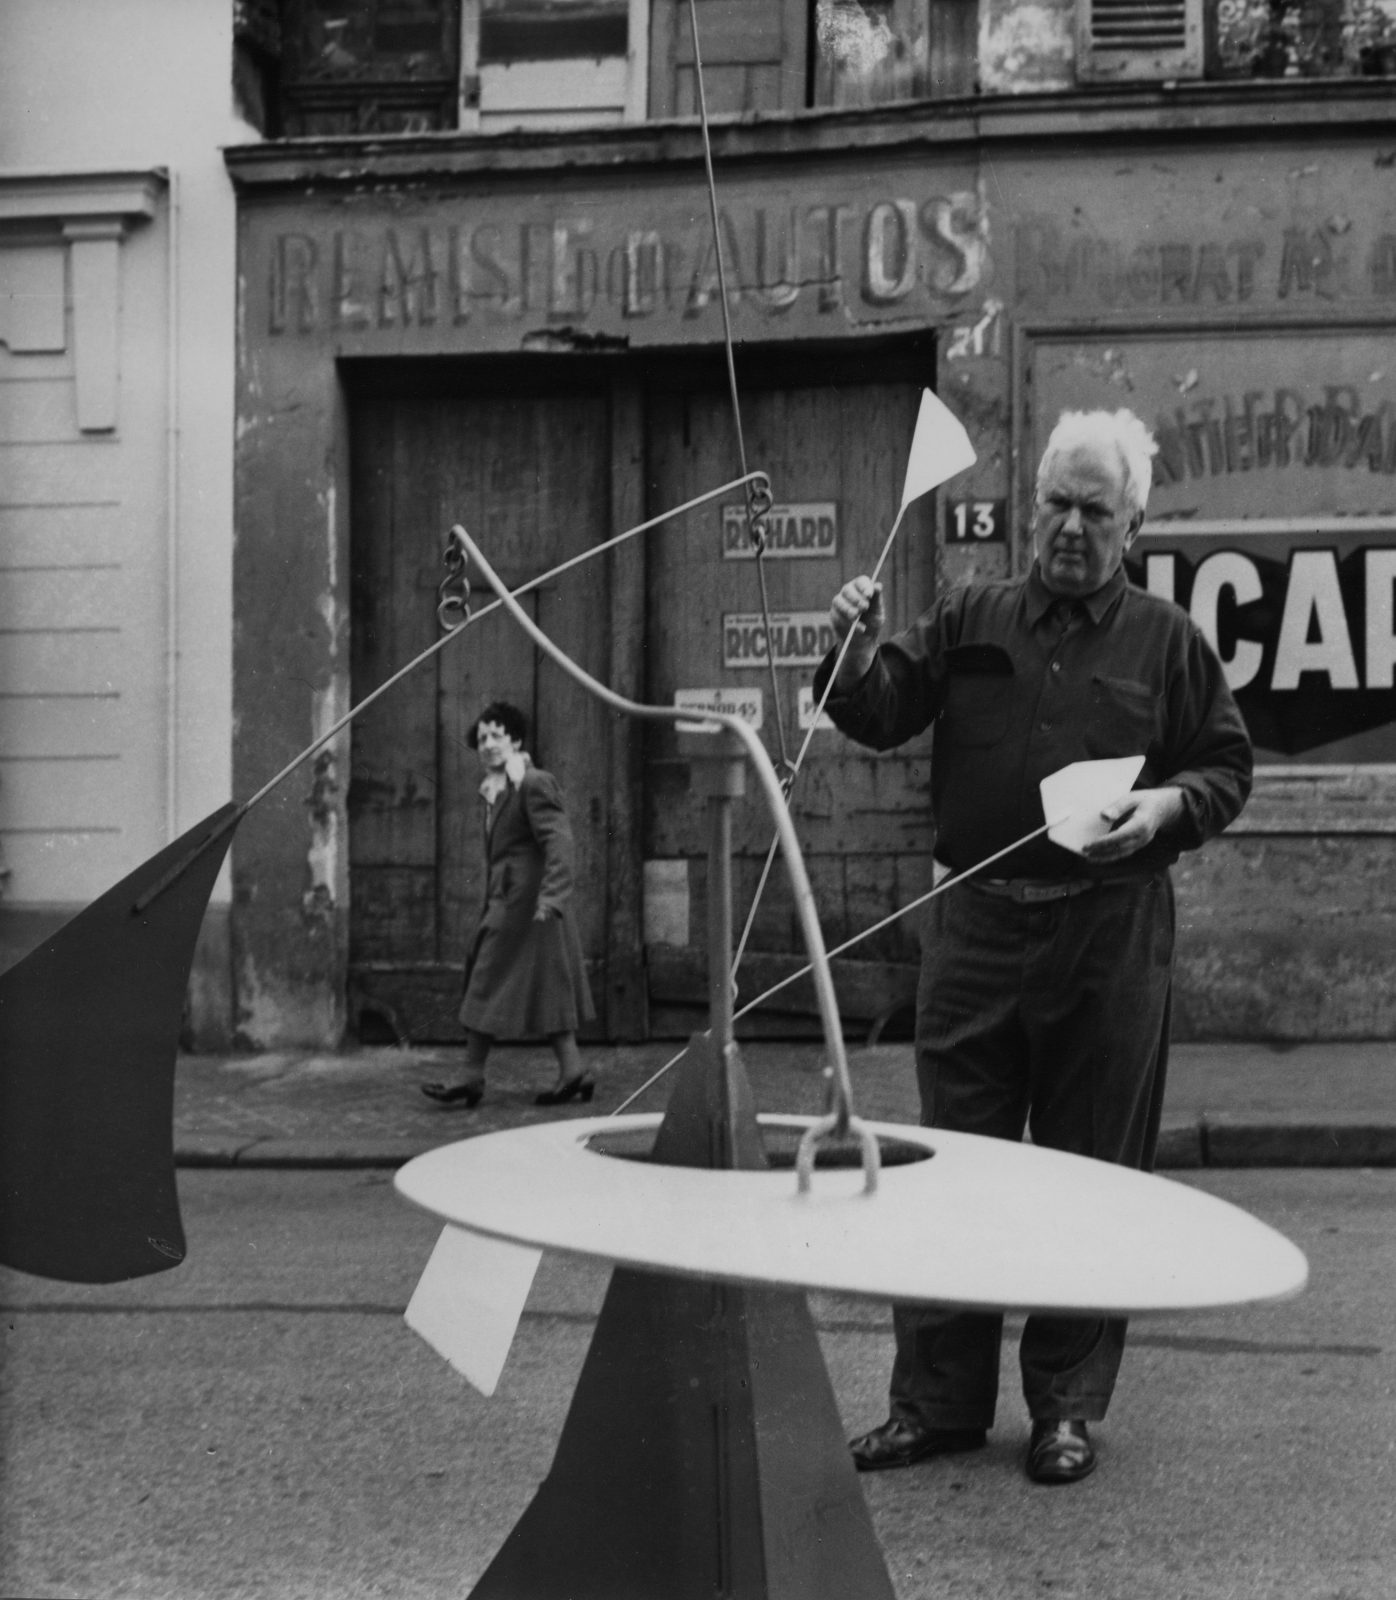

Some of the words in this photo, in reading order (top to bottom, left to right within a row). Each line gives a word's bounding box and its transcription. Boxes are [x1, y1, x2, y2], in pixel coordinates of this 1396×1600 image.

[726, 516, 834, 550] RIHARD
[953, 501, 996, 539] 13
[726, 624, 834, 659] RICHARD
